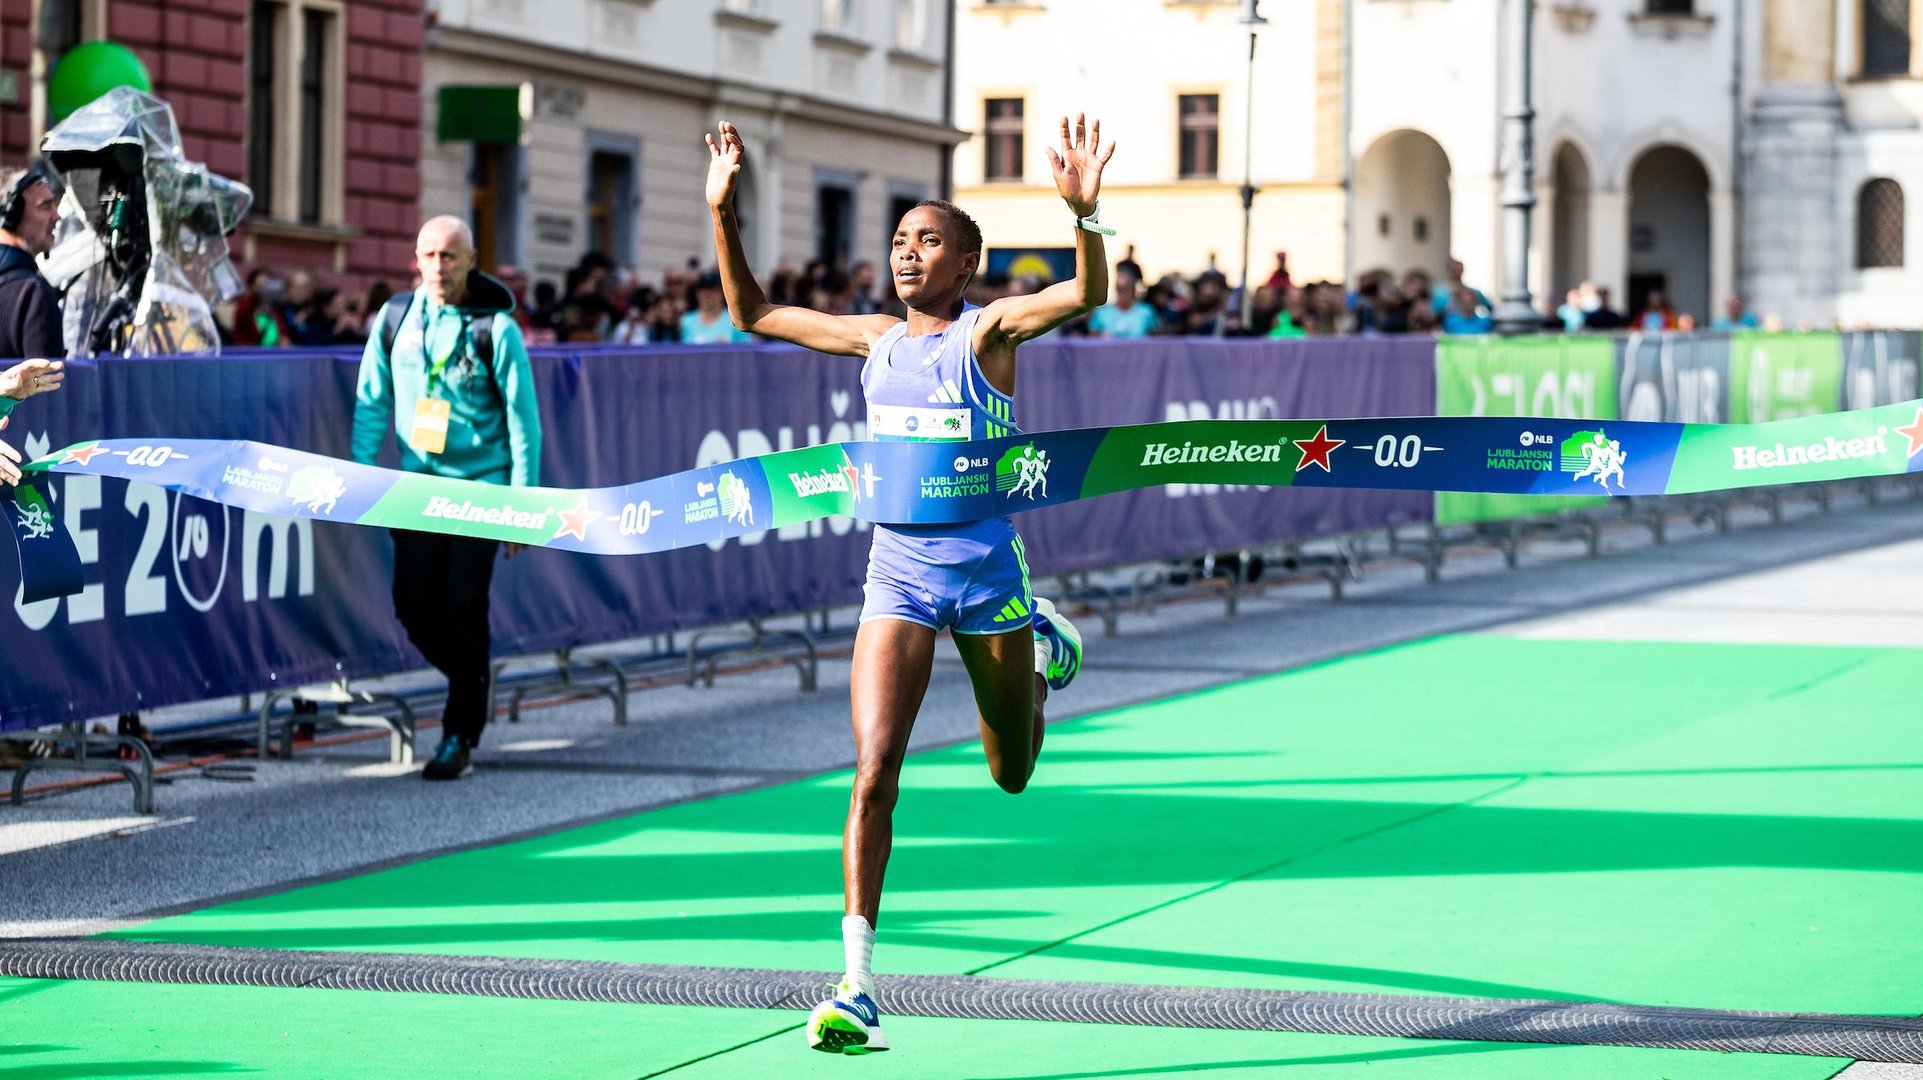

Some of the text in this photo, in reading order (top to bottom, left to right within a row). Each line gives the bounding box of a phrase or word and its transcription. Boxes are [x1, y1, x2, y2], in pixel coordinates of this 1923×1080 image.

[1535, 435, 1553, 444] NLB
[1487, 448, 1552, 459] LJUBLJANSKI
[970, 457, 989, 468] NLB
[1487, 458, 1552, 471] MARATON
[222, 473, 282, 494] MARATON
[920, 473, 989, 486] LJUBLJANSKI
[920, 483, 989, 498] MARATON
